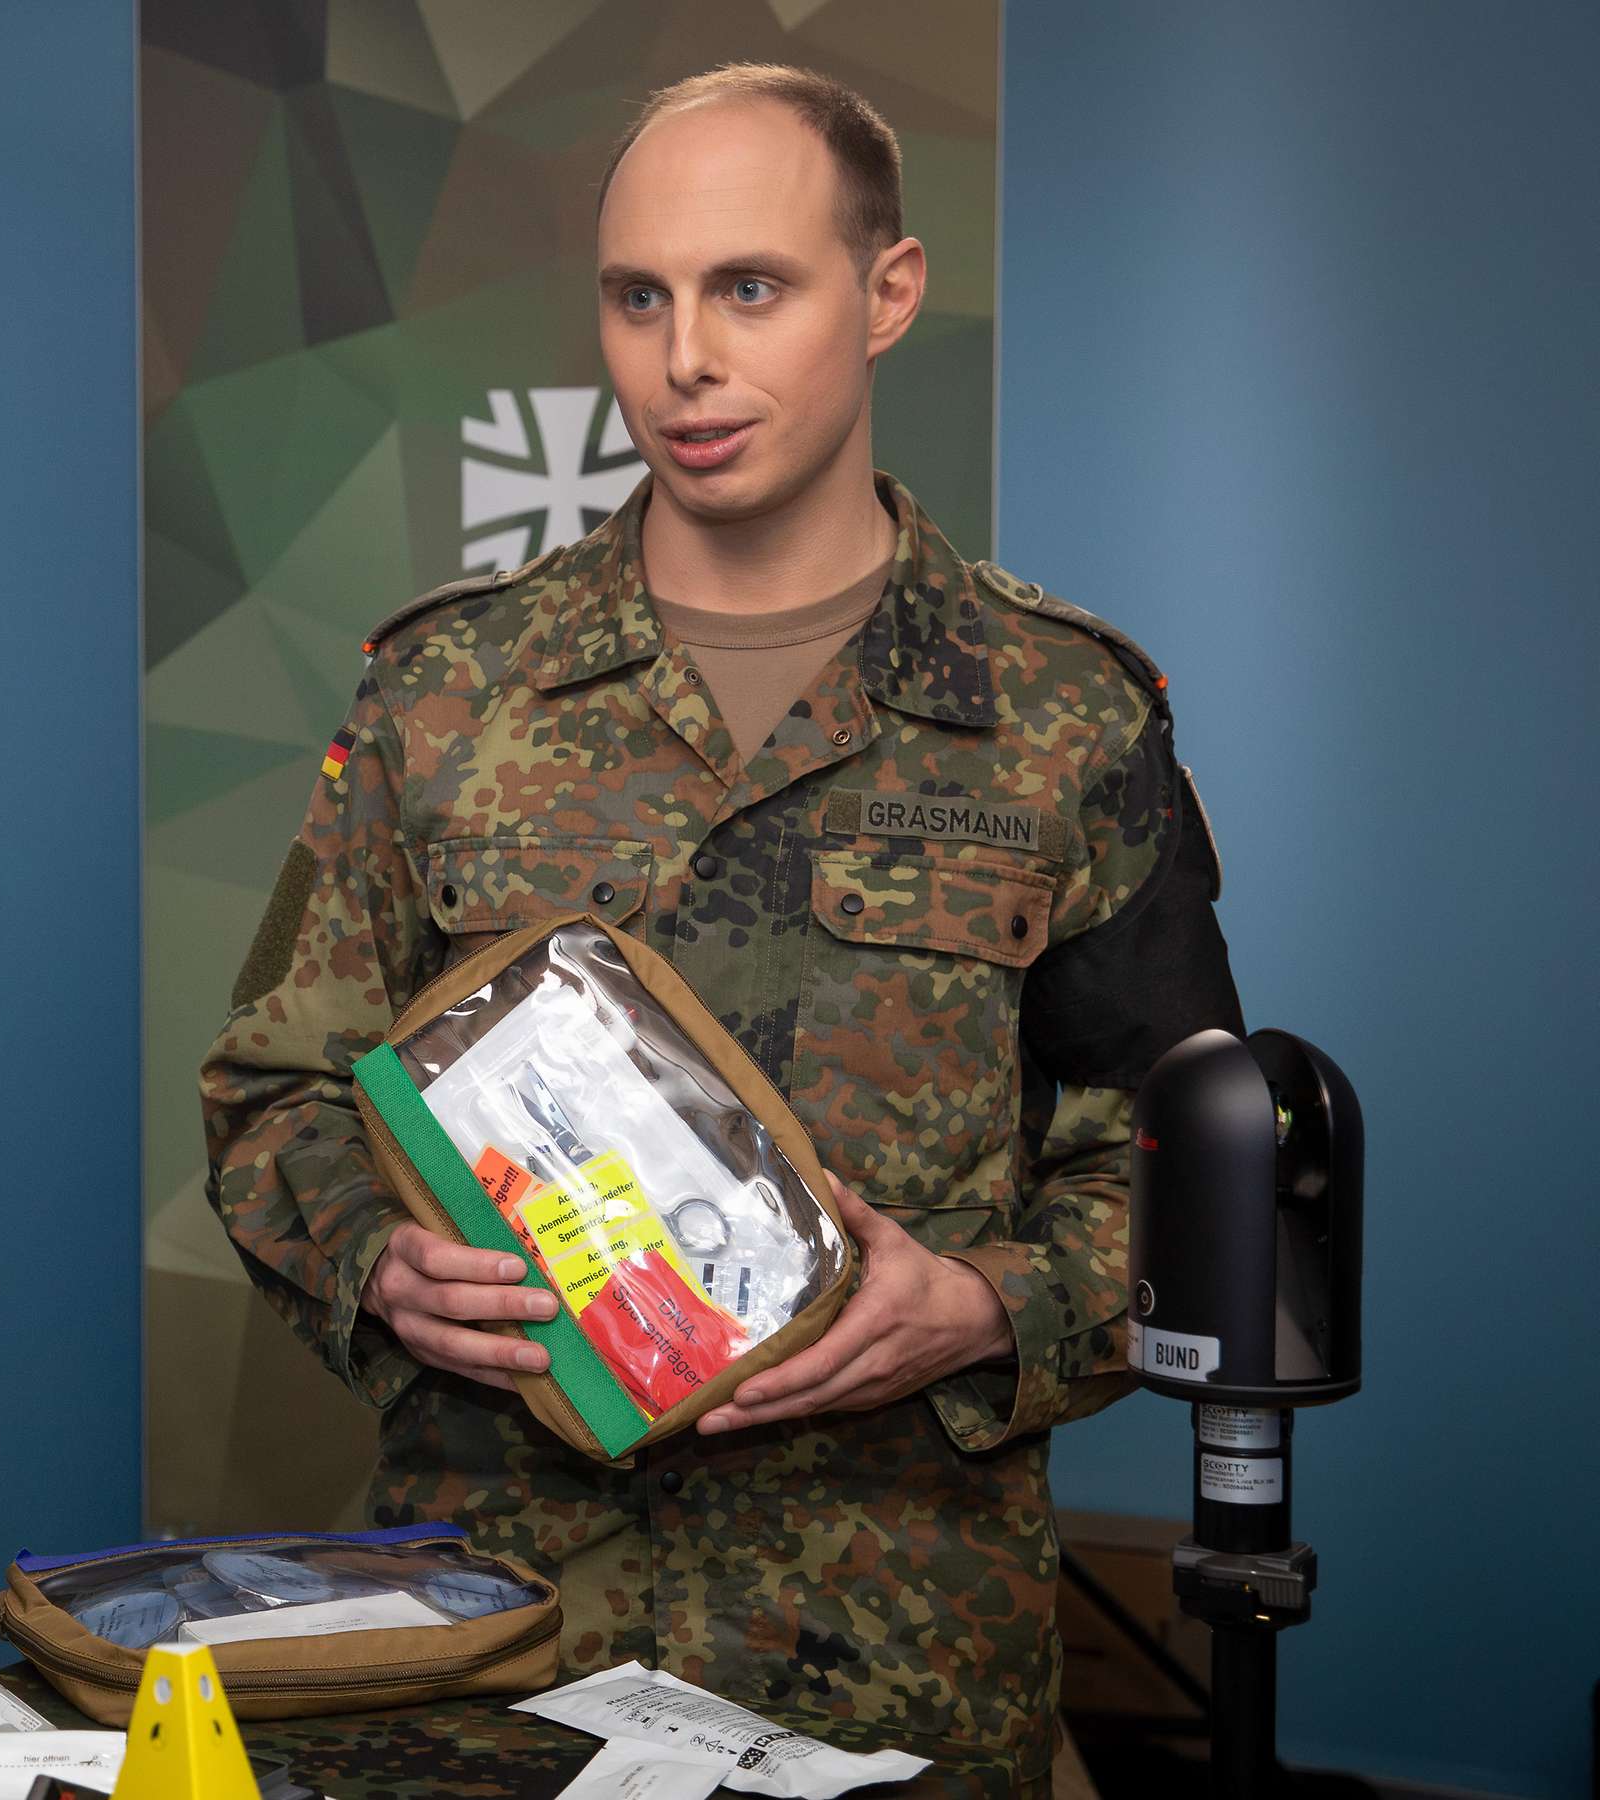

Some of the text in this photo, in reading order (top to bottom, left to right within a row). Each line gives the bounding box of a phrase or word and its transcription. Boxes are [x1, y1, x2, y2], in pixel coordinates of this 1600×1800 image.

[866, 800, 1033, 845] GRASMANN
[536, 1207, 580, 1235] chemisch
[587, 1239, 629, 1264] Achung,
[566, 1265, 610, 1293] chemisch
[658, 1297, 698, 1345] DNA-
[1155, 1342, 1200, 1371] BUND
[1202, 1459, 1249, 1473] SCOTTY
[42, 1754, 70, 1762] öffnen
